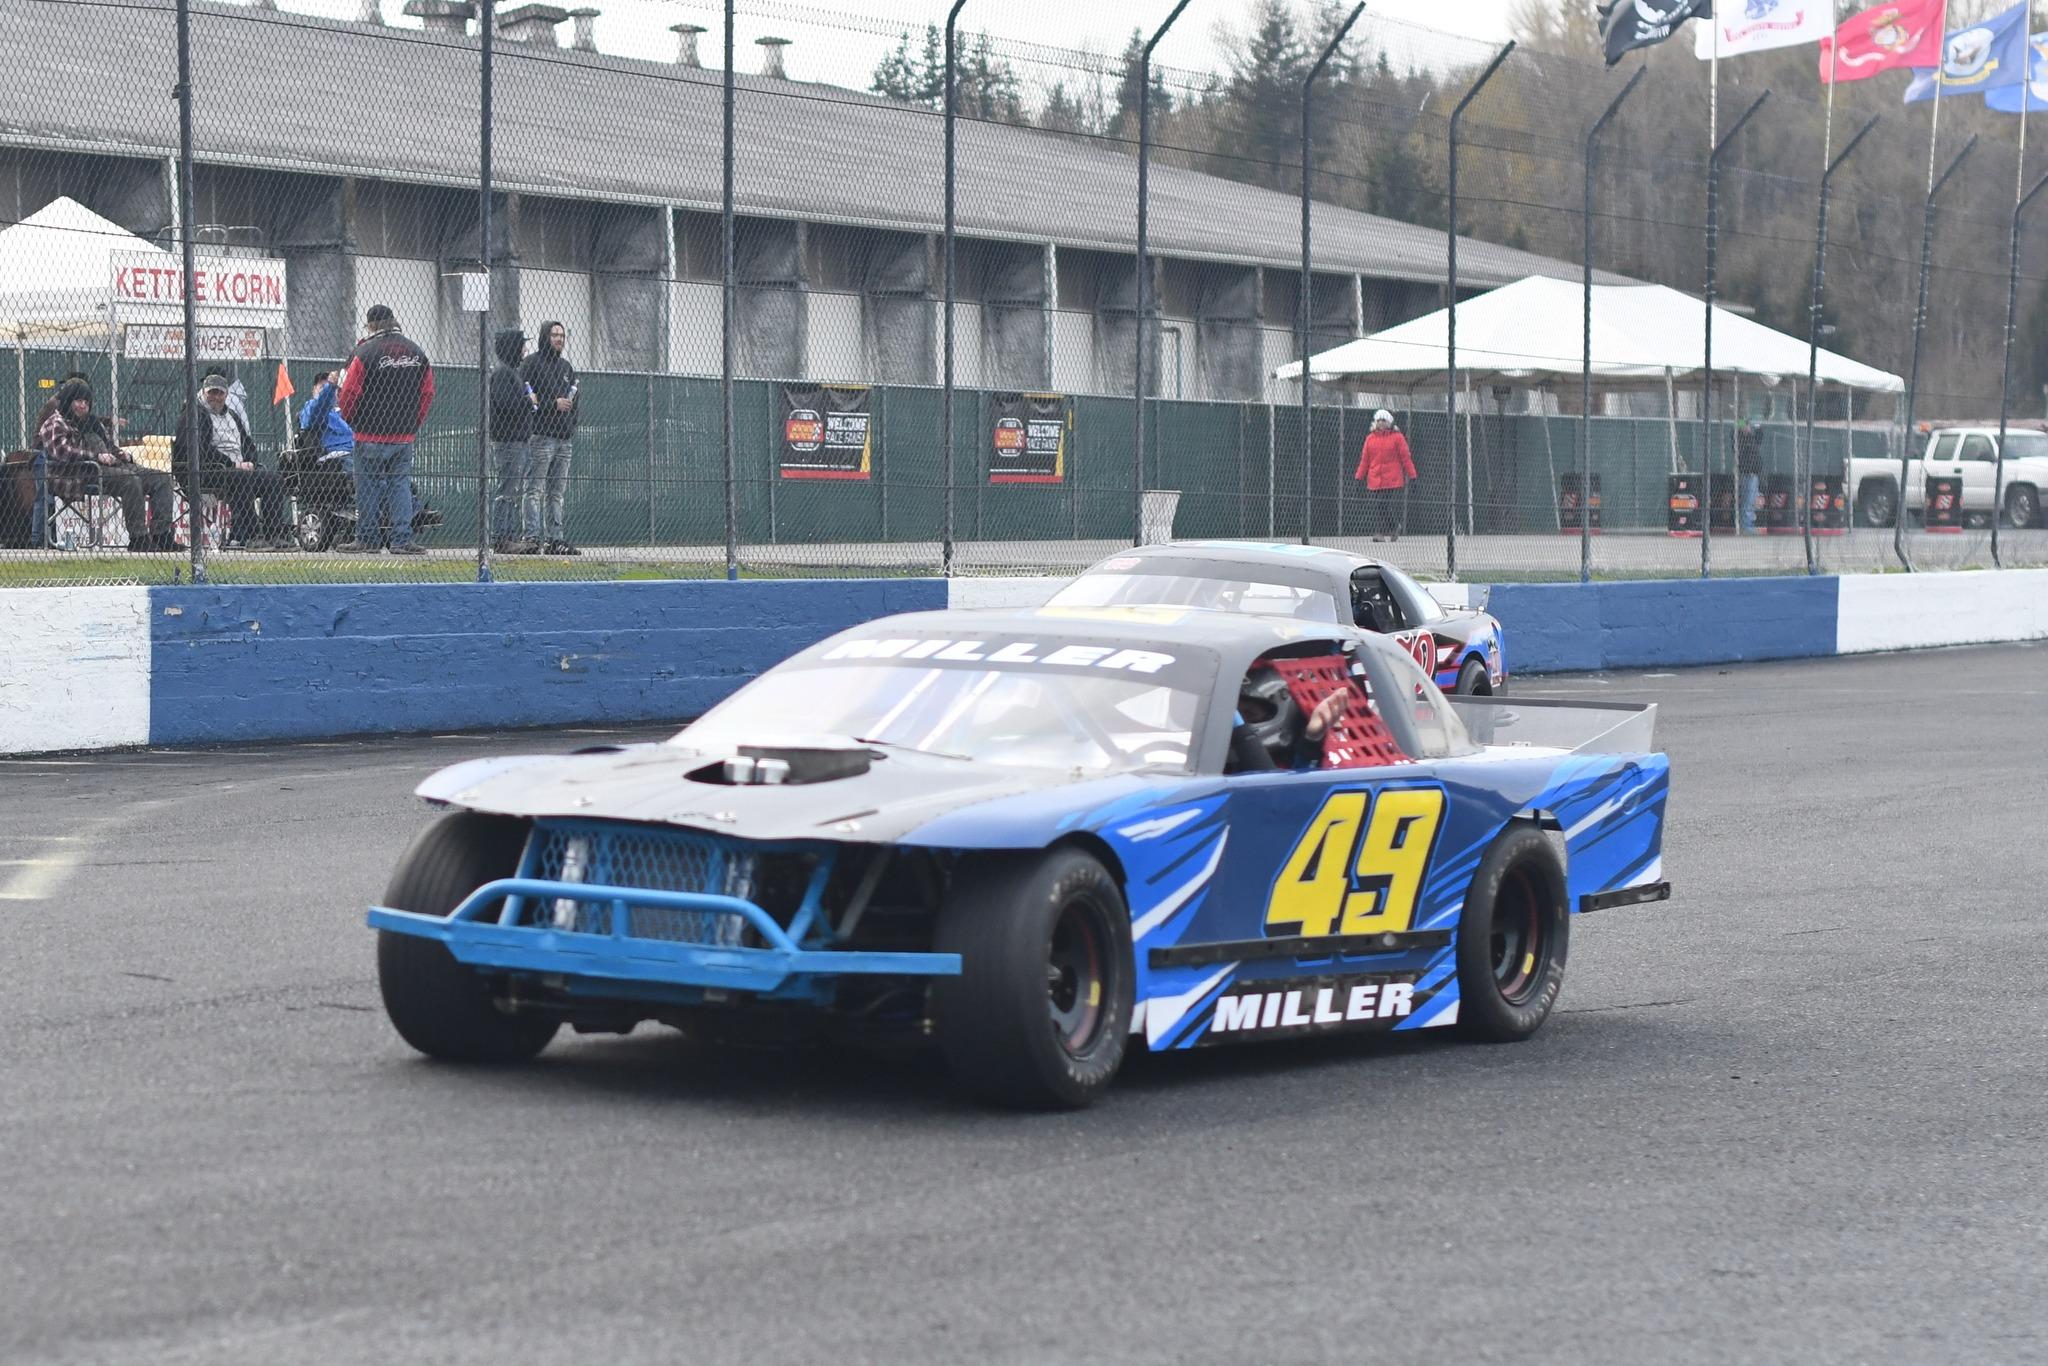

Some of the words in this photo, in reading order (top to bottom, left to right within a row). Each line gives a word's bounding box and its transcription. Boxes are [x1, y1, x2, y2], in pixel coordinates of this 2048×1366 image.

[116, 267, 206, 301] KETTLE
[215, 272, 281, 305] KORN
[827, 417, 867, 431] WELCOME
[1027, 424, 1061, 438] WELCOME
[822, 639, 1177, 673] MILLER
[1264, 788, 1446, 937] 49
[1210, 982, 1415, 1032] MILLER
